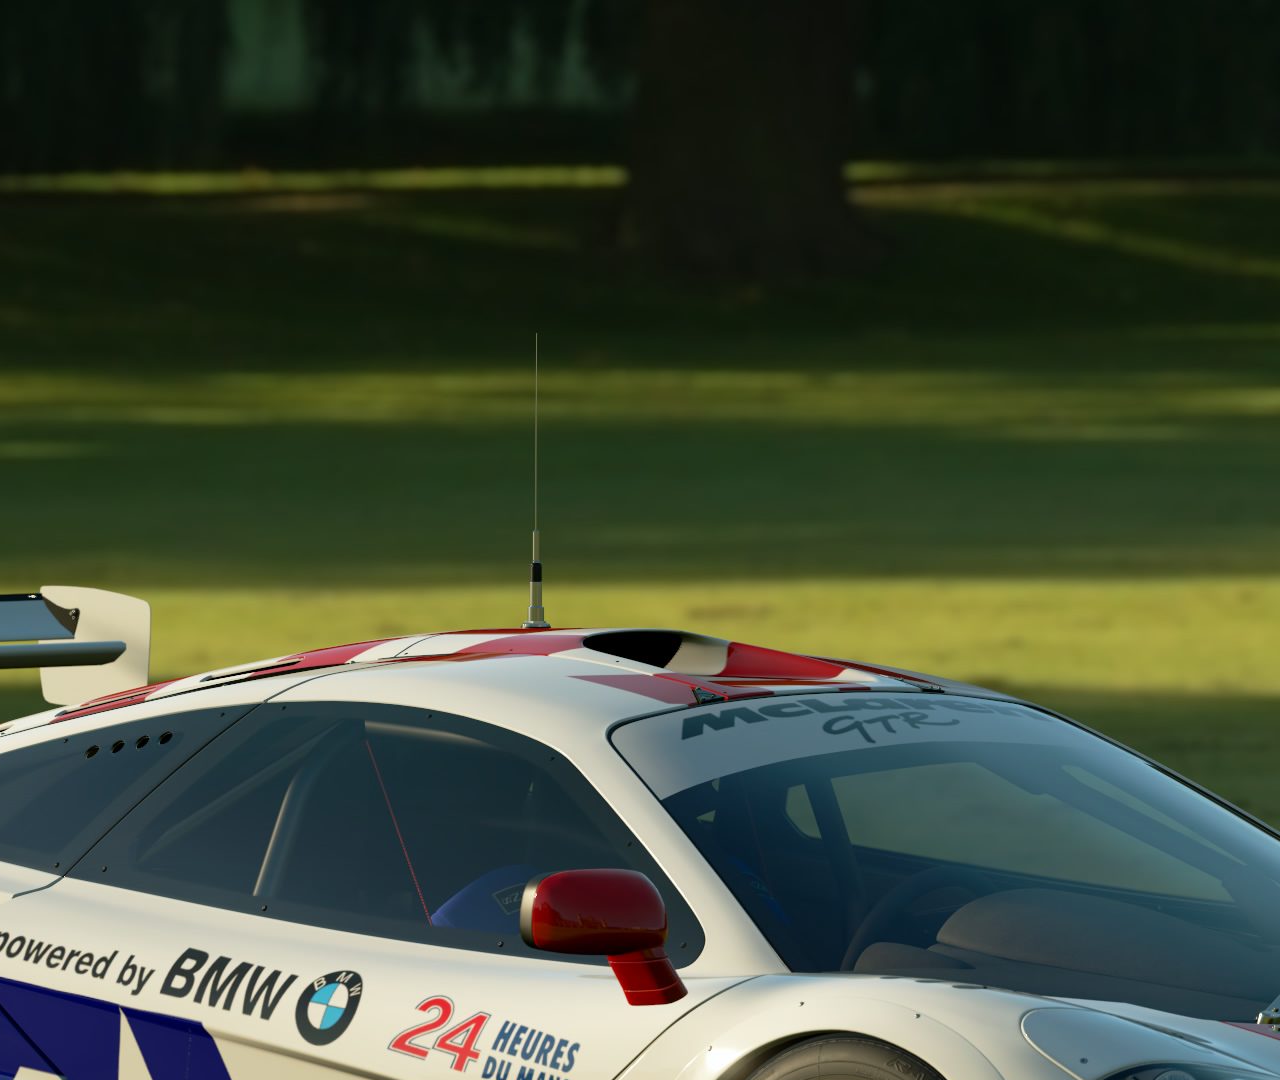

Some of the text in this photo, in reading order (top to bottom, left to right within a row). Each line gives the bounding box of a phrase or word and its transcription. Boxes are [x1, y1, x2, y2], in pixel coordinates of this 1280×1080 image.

[822, 711, 960, 744] GTR
[116, 954, 156, 996] by
[160, 947, 300, 1021] BMW
[387, 995, 492, 1073] 24
[490, 1019, 581, 1074] HEURES
